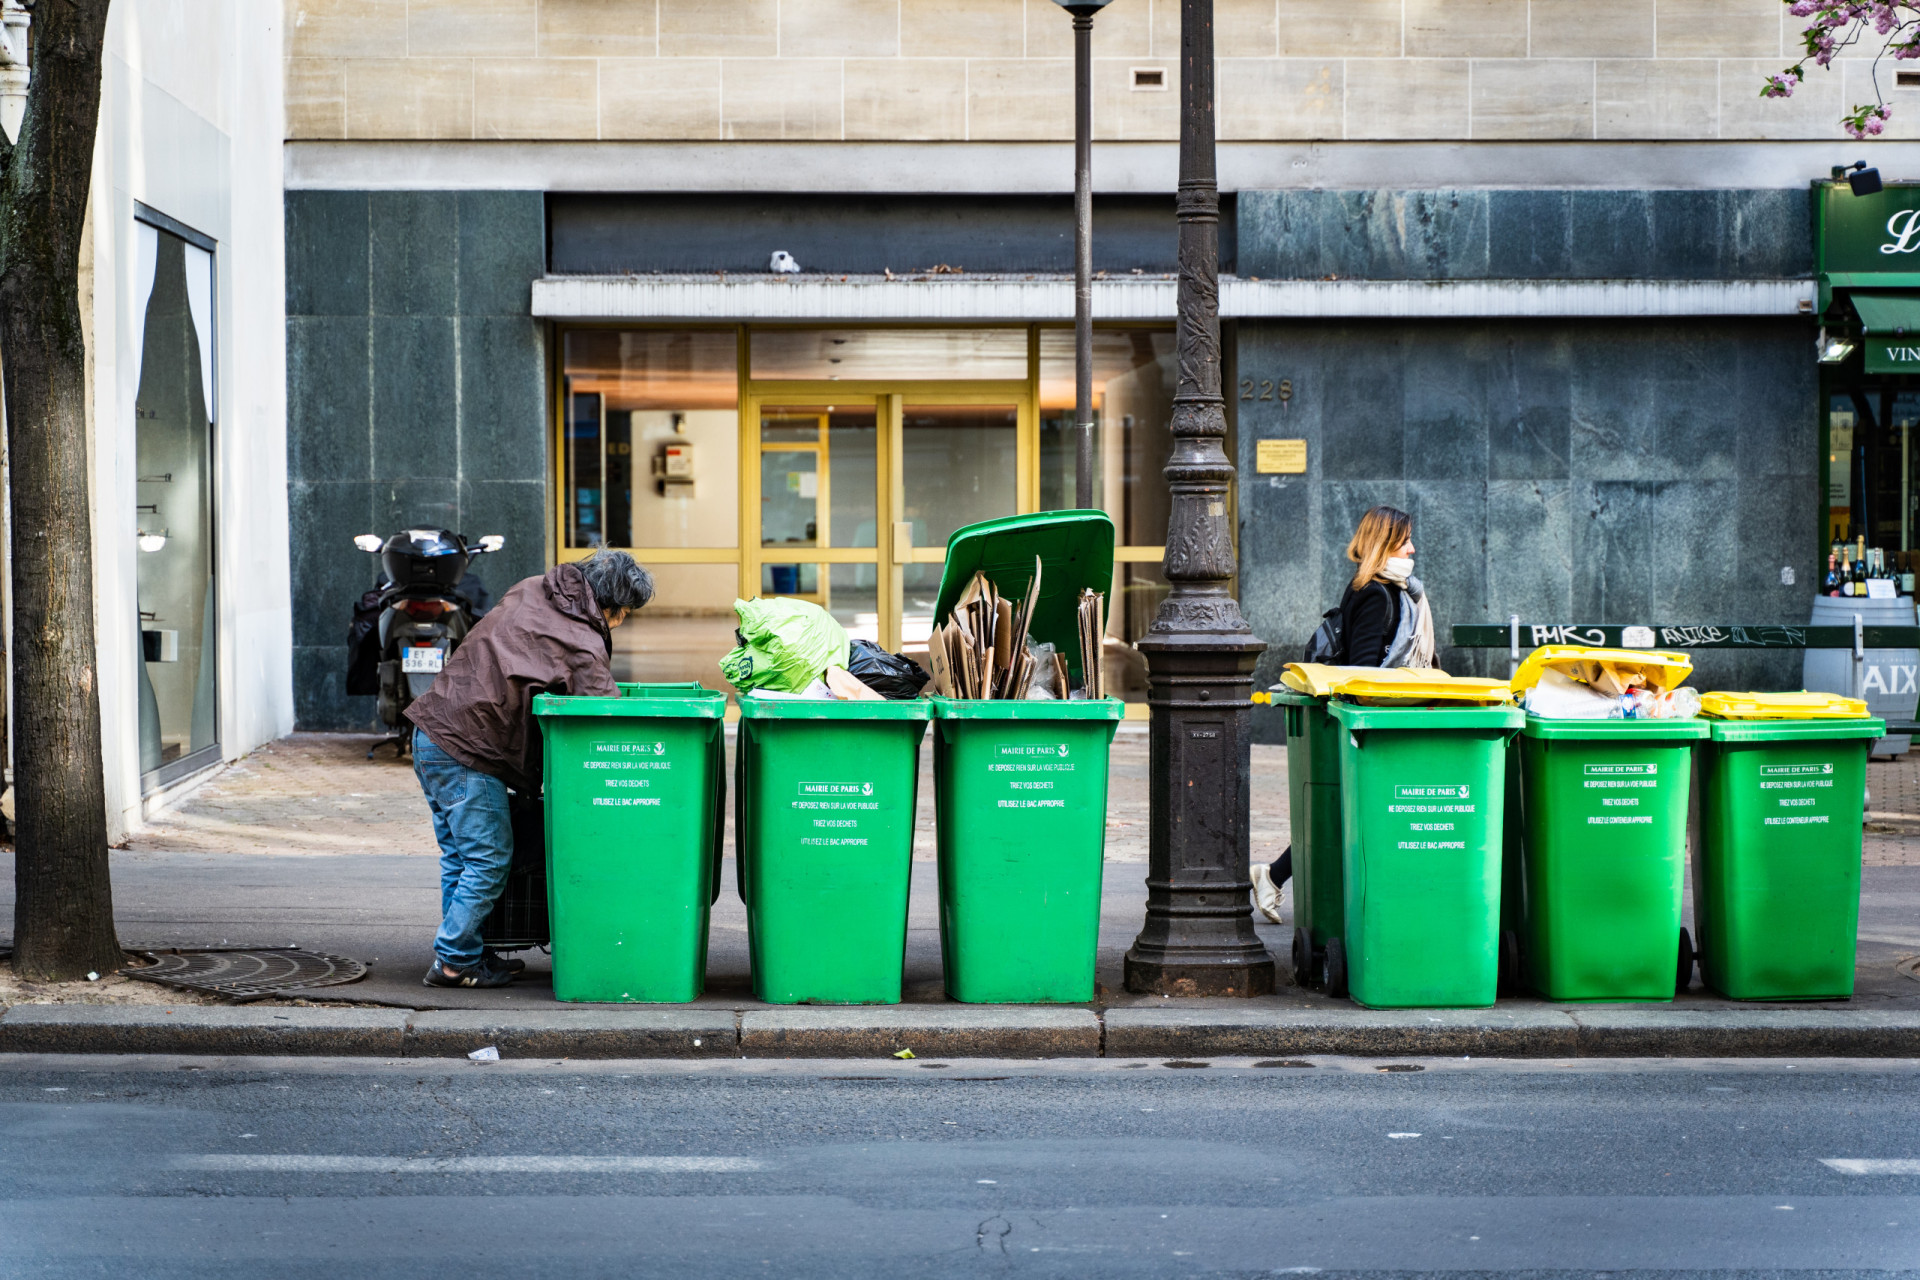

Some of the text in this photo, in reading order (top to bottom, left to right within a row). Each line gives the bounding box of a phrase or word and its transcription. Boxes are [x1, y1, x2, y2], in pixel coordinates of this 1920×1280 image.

[1240, 379, 1293, 400] 228
[413, 650, 425, 659] ET
[1864, 665, 1918, 695] AIX
[1402, 788, 1455, 796] MAIRIE DE PARIS
[593, 798, 660, 806] UTILISEZ LE BAC APPROPRIE
[998, 800, 1064, 808] UTILISEZ LE BAC APPROPRIE
[1410, 823, 1454, 831] TRIEZ VOS DECHETS
[801, 838, 868, 846] UTILISEZ LE BAC APPROPRIE
